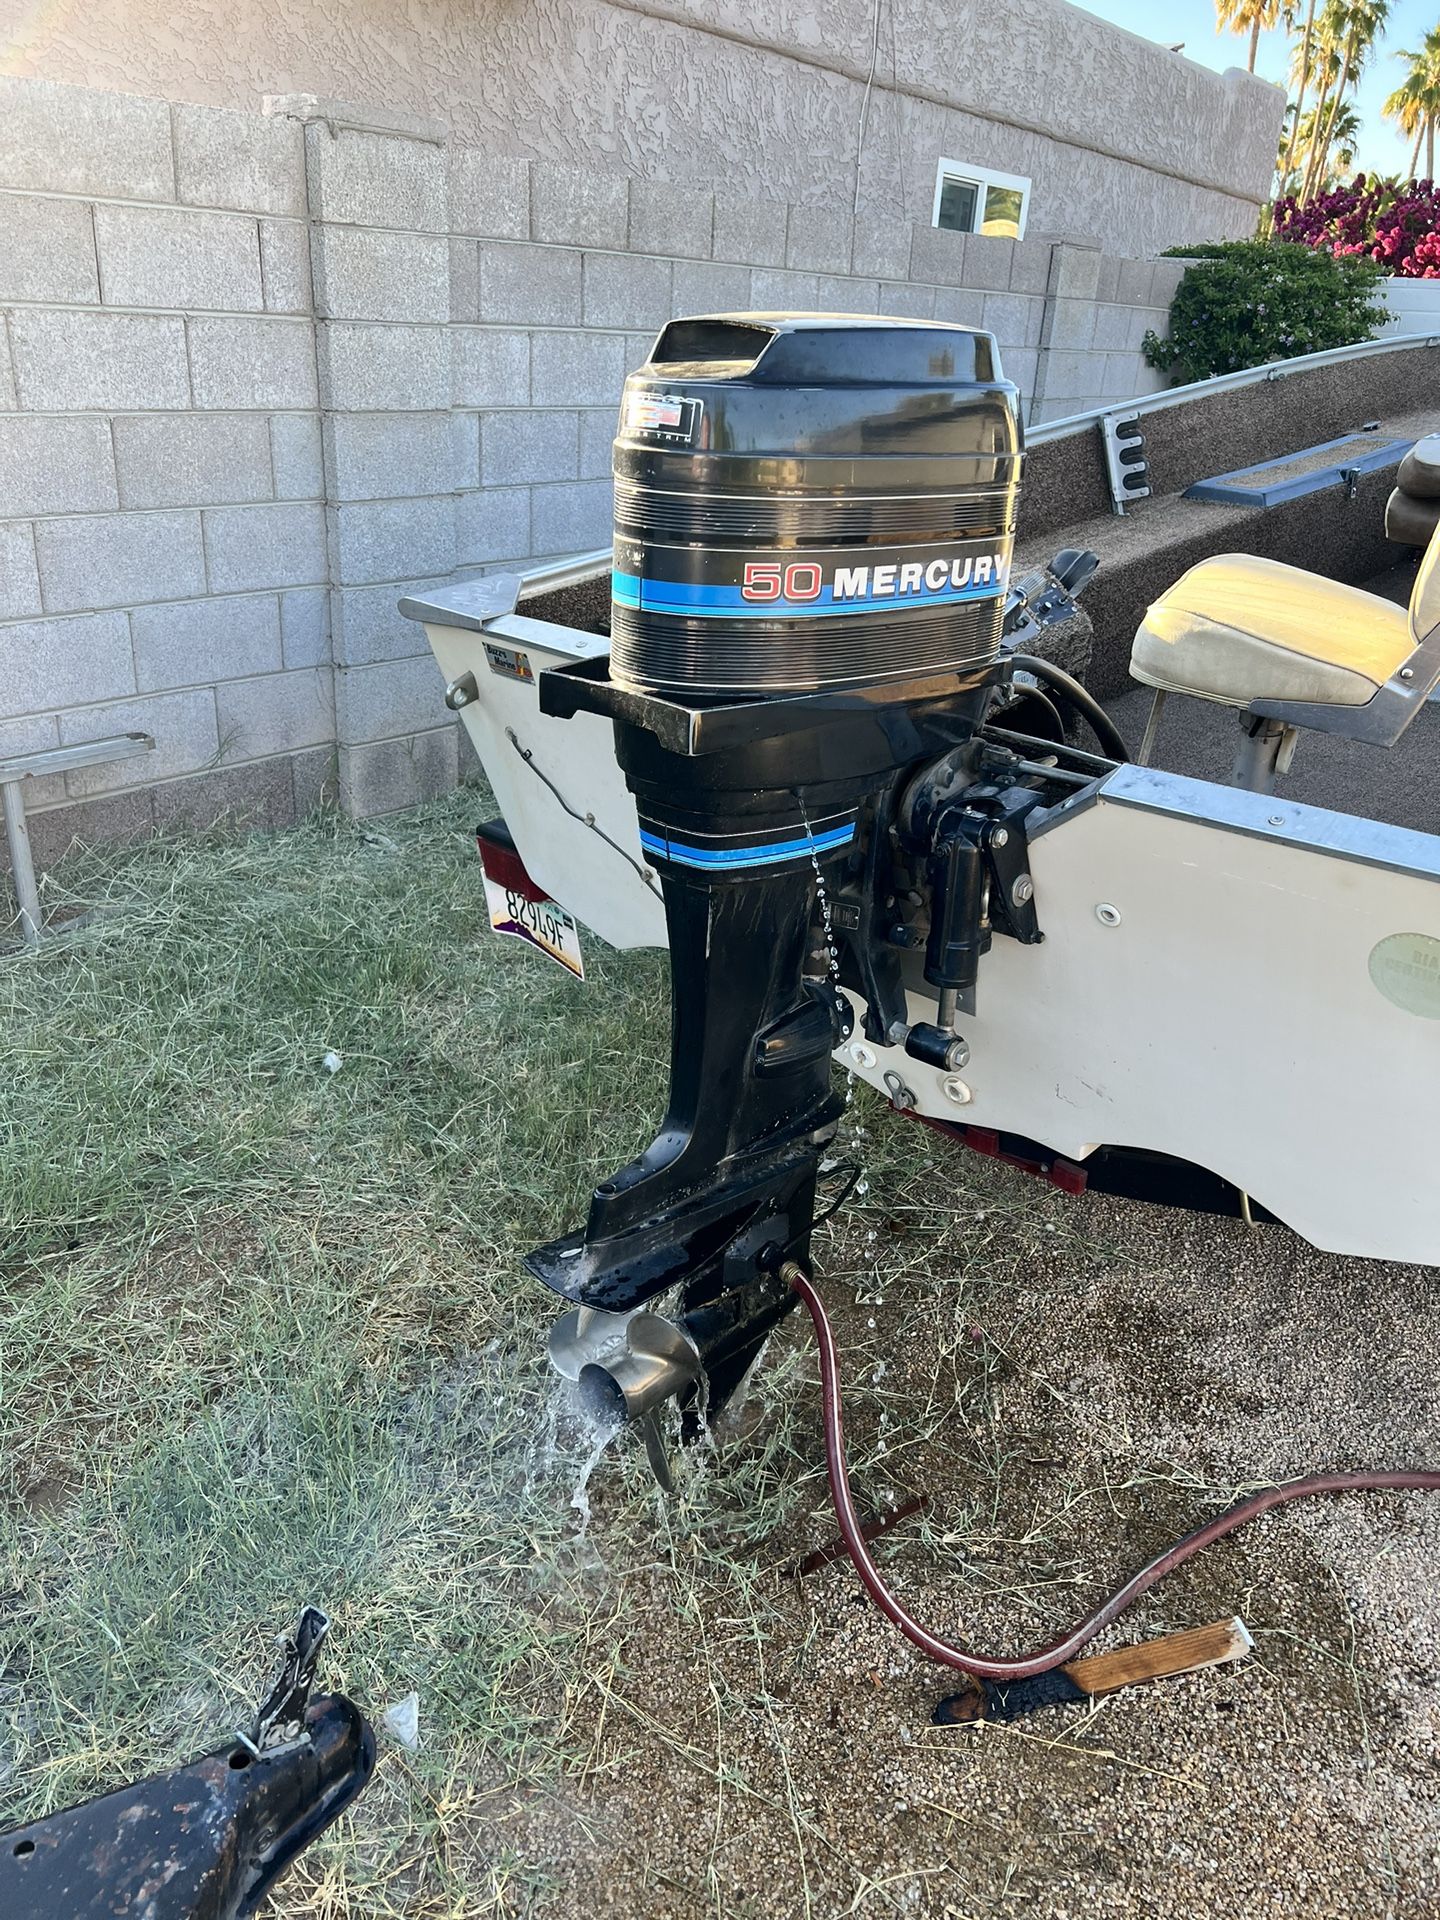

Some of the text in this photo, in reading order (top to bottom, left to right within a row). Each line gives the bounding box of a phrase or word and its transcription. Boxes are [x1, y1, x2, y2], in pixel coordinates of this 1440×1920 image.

[656, 433, 691, 443] TRIM
[741, 554, 1008, 602] 50 MERCURY
[505, 888, 564, 951] 82949F
